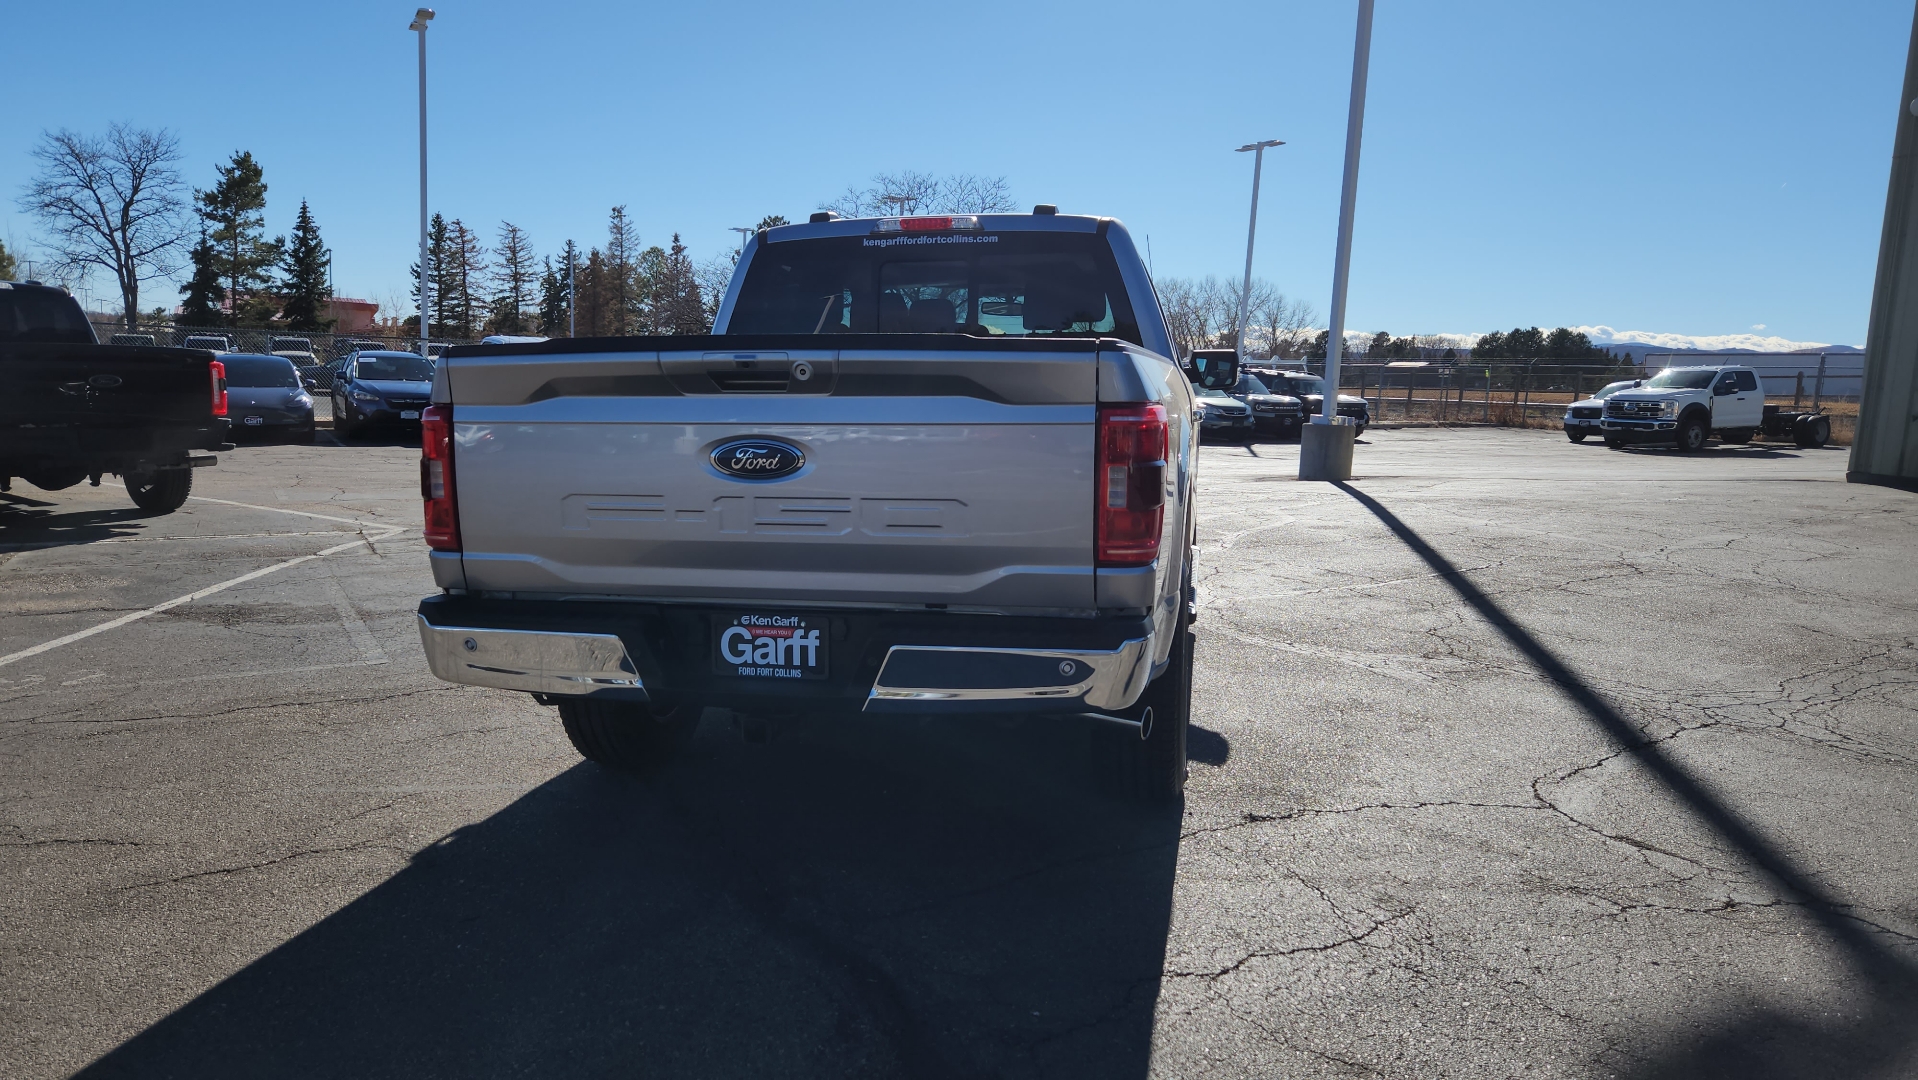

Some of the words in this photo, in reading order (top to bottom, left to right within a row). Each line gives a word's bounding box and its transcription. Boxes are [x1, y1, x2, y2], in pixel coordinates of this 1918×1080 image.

[863, 235, 999, 248] kengarfffordfortcollins.com
[731, 447, 781, 470] Ford
[561, 493, 970, 538] F-150
[750, 615, 771, 626] Ken
[772, 616, 799, 627] Garff
[720, 626, 820, 667] Garff
[738, 666, 756, 676] FORD
[757, 667, 773, 677] FORT
[774, 668, 802, 678] COLLINS
